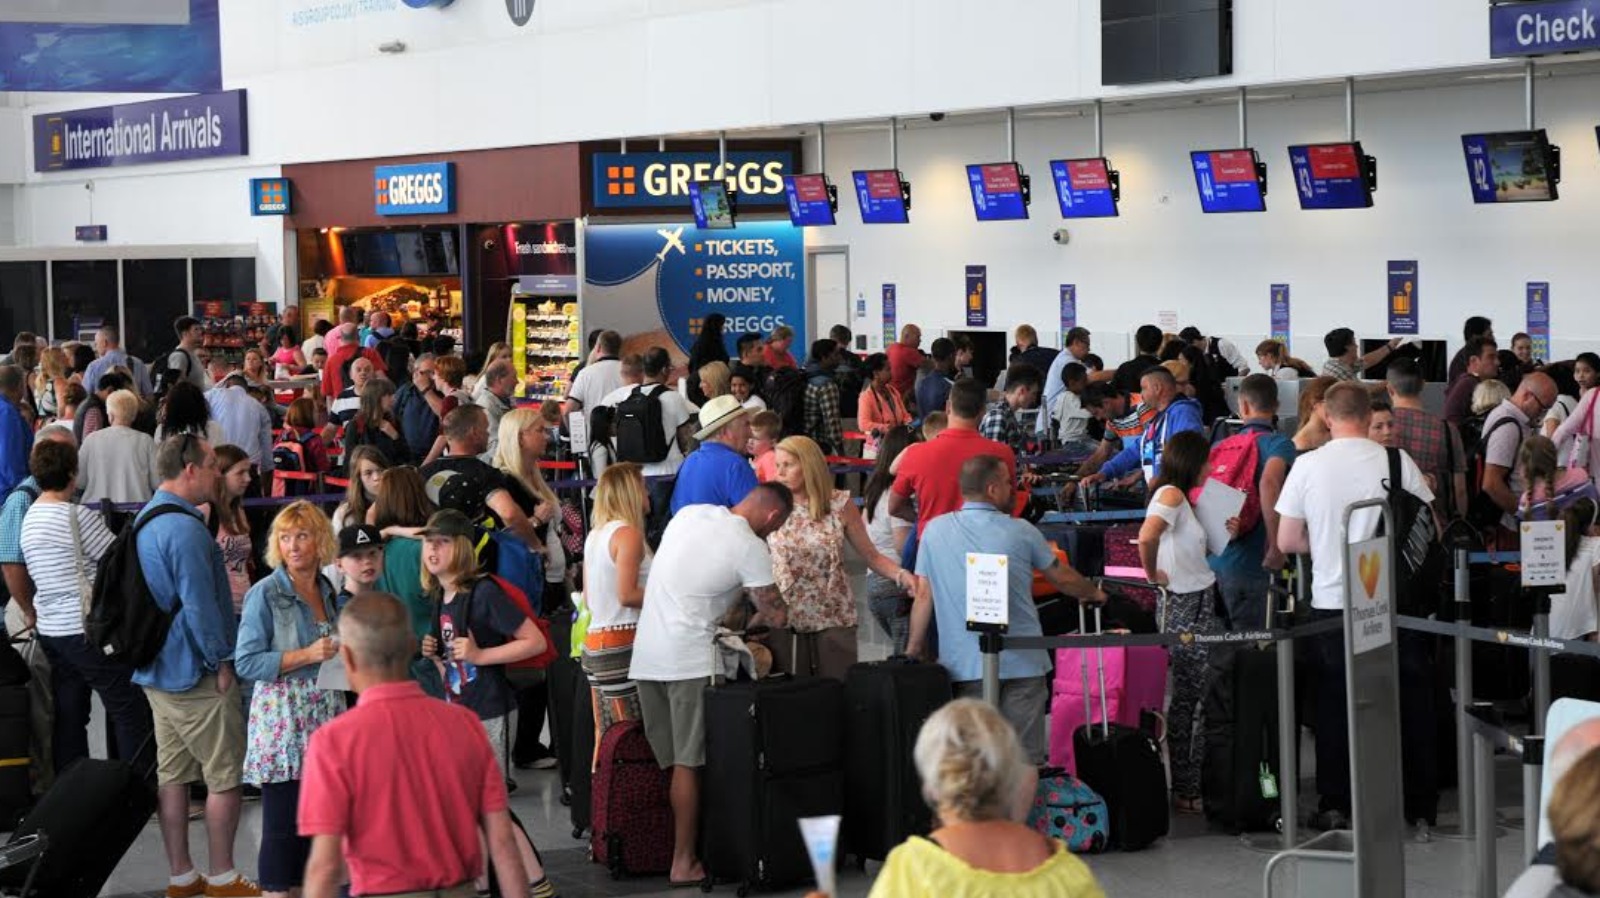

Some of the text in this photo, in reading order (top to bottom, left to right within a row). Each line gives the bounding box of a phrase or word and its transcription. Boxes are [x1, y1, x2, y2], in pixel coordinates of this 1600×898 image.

[1516, 8, 1596, 46] Check
[64, 106, 223, 161] International Arrivals
[643, 161, 784, 197] GREGGS
[1473, 158, 1489, 190] 42
[388, 172, 443, 206] GREGGS
[258, 203, 287, 212] GREGGS
[704, 238, 779, 257] TICKETS,
[706, 262, 796, 281] PASSPORT,
[706, 286, 775, 304] MONEY,
[723, 315, 785, 334] REGGS
[1351, 600, 1389, 623] Thomas Cook
[1194, 630, 1272, 643] Thomas Cook Airlines
[1363, 619, 1384, 637] Airlines
[1507, 633, 1565, 650] Thomas Cook Airlines
